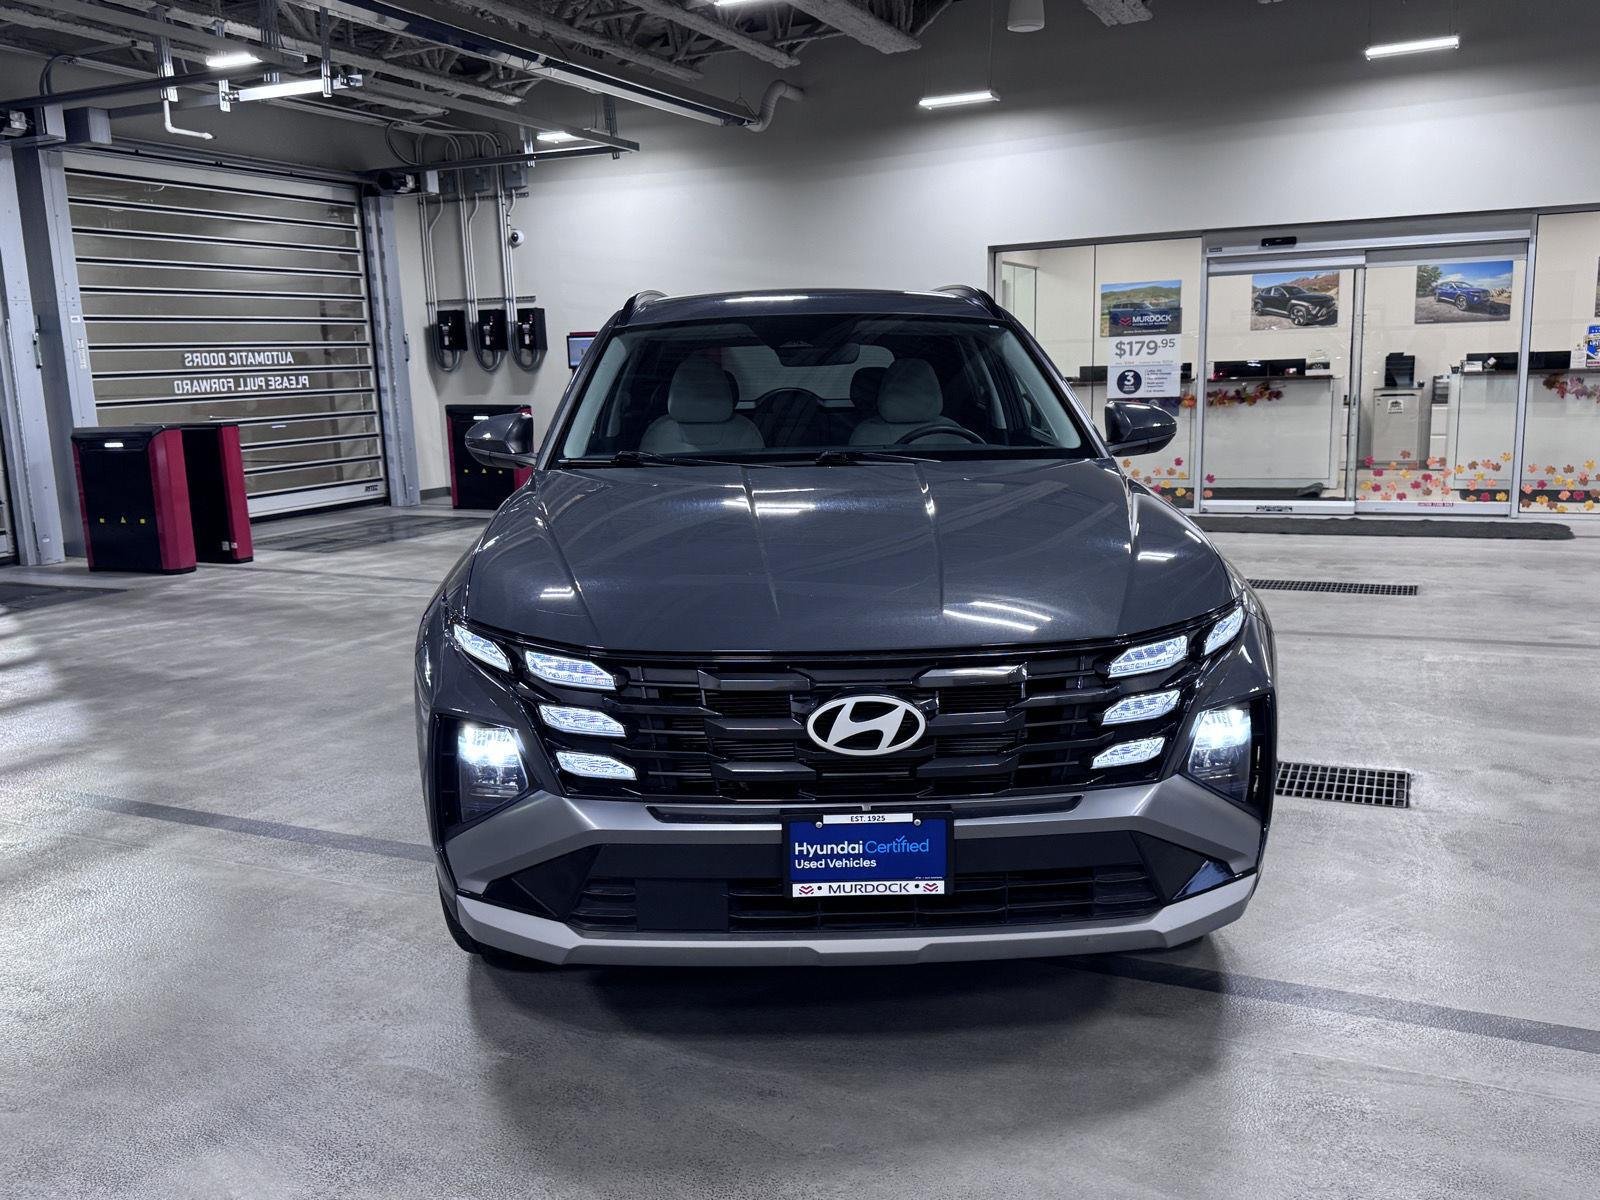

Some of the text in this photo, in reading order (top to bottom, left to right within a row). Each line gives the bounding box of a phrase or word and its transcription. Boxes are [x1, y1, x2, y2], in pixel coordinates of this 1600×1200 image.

[1132, 314, 1172, 323] MURDOCK
[1124, 371, 1135, 385] 3
[794, 836, 930, 858] Hyundai Certified
[795, 857, 877, 869] Used Vehicles
[828, 882, 910, 895] MURDOCK
